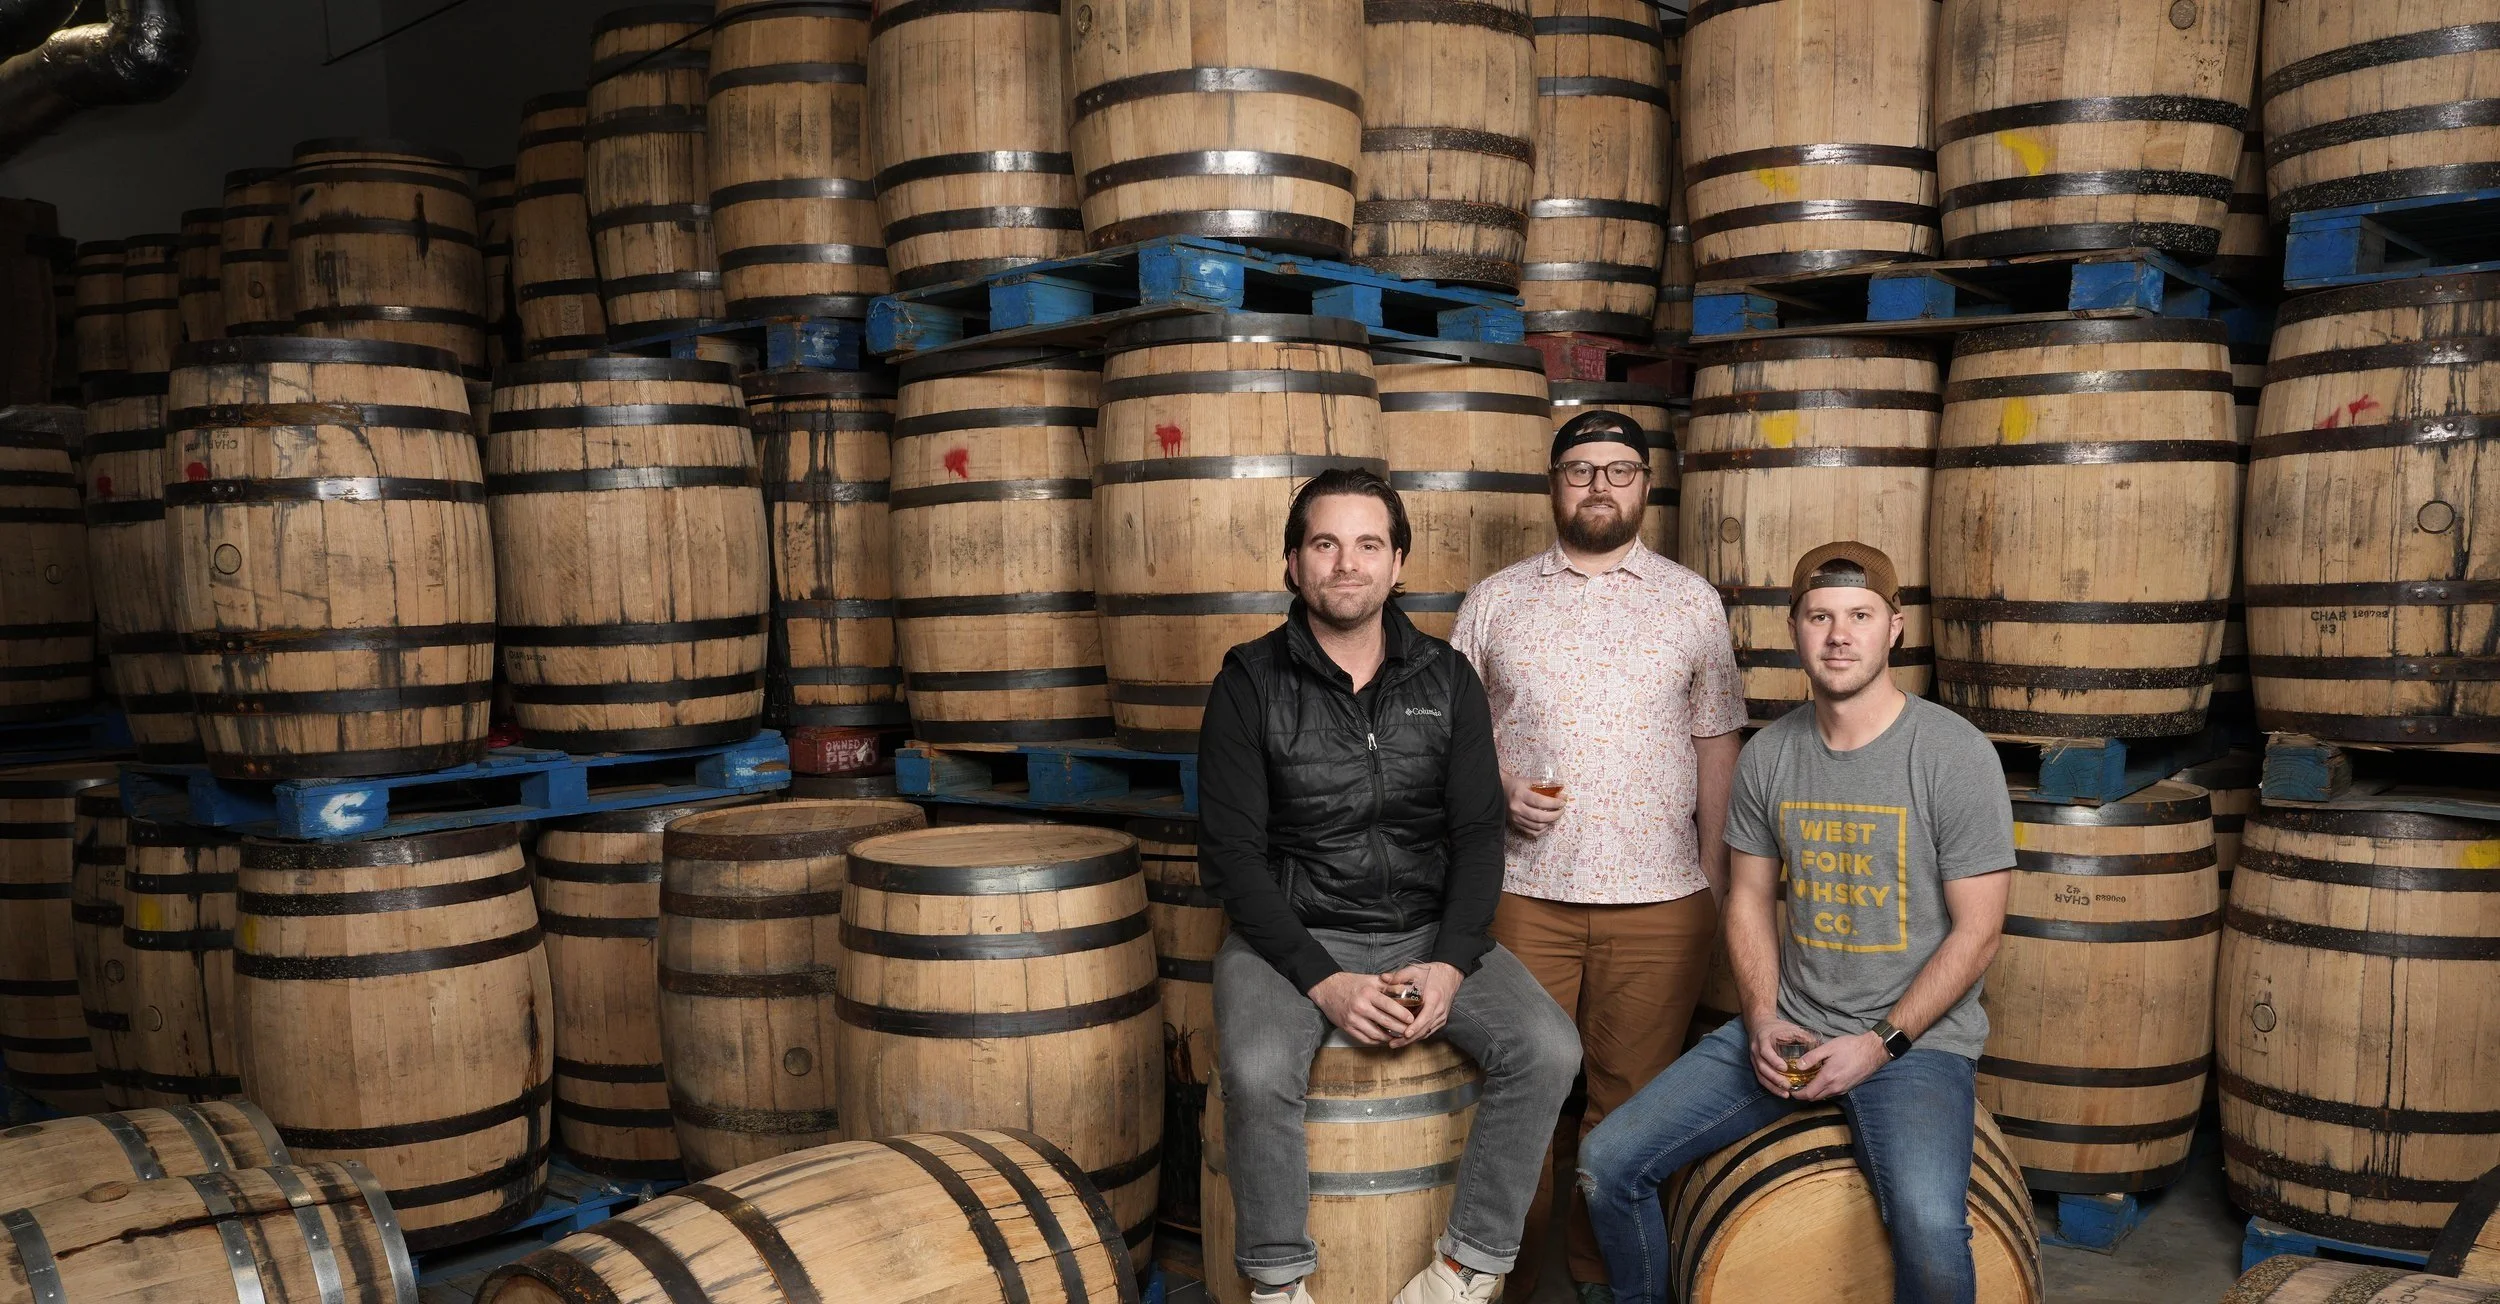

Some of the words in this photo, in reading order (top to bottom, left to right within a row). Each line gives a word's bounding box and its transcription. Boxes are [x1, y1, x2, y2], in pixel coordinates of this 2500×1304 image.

[2310, 611, 2347, 621] CHAR
[2319, 624, 2336, 634] #3
[1412, 707, 1442, 717] Columbia
[826, 740, 860, 751] OWNED
[826, 750, 877, 771] PECO
[1799, 819, 1877, 845] WEST
[1800, 850, 1874, 876] FORK
[2066, 884, 2081, 895] #2
[2054, 893, 2090, 906] CHAR
[1814, 911, 1861, 937] CO.
